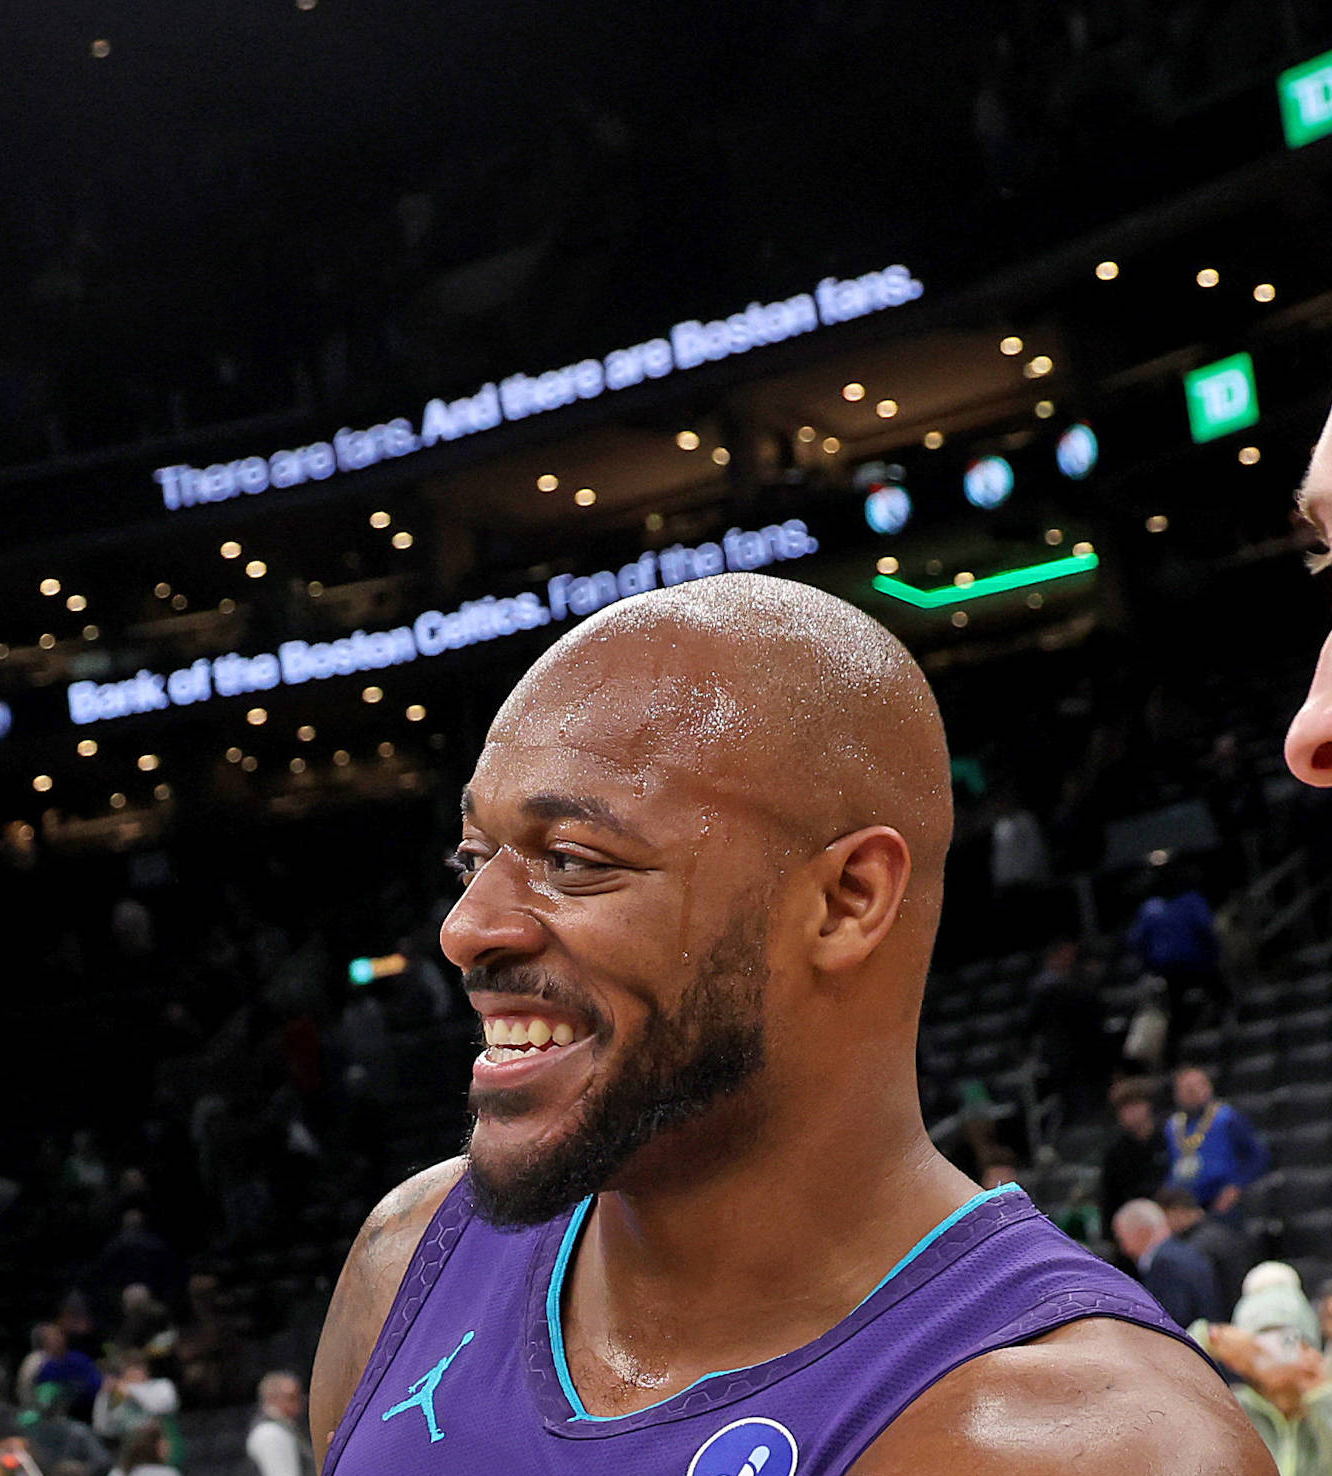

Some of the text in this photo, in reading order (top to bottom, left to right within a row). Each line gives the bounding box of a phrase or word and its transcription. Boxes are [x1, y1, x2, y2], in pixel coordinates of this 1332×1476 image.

[153, 264, 924, 510] There are fans. And there are Boston fans.
[1194, 368, 1250, 425] TD
[68, 519, 819, 724] Bank of the Boston Celtics. Fan of the fans.
